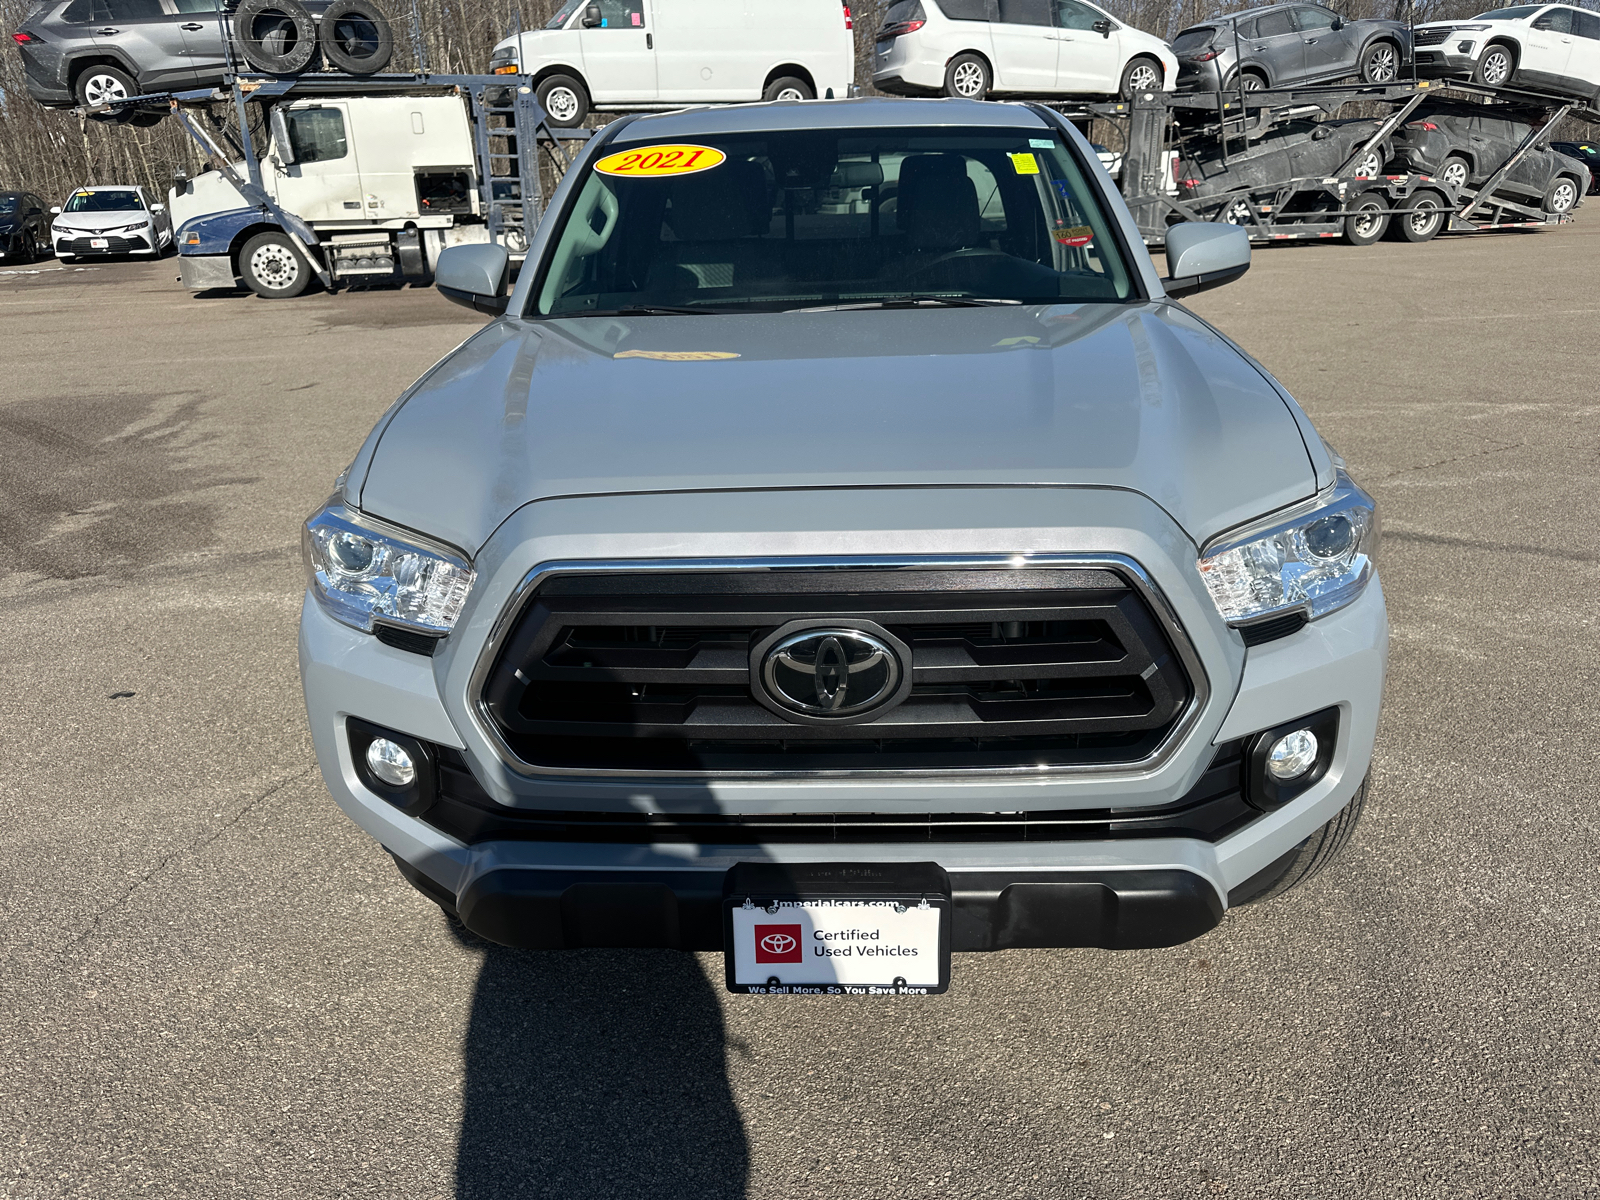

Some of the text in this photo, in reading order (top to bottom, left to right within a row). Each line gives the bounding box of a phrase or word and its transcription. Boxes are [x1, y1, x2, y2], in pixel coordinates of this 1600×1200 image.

[613, 150, 705, 171] 2021
[813, 929, 880, 941] Certified
[814, 945, 919, 957] Used Vehicles
[748, 986, 928, 995] We Sell More, So You Save More
